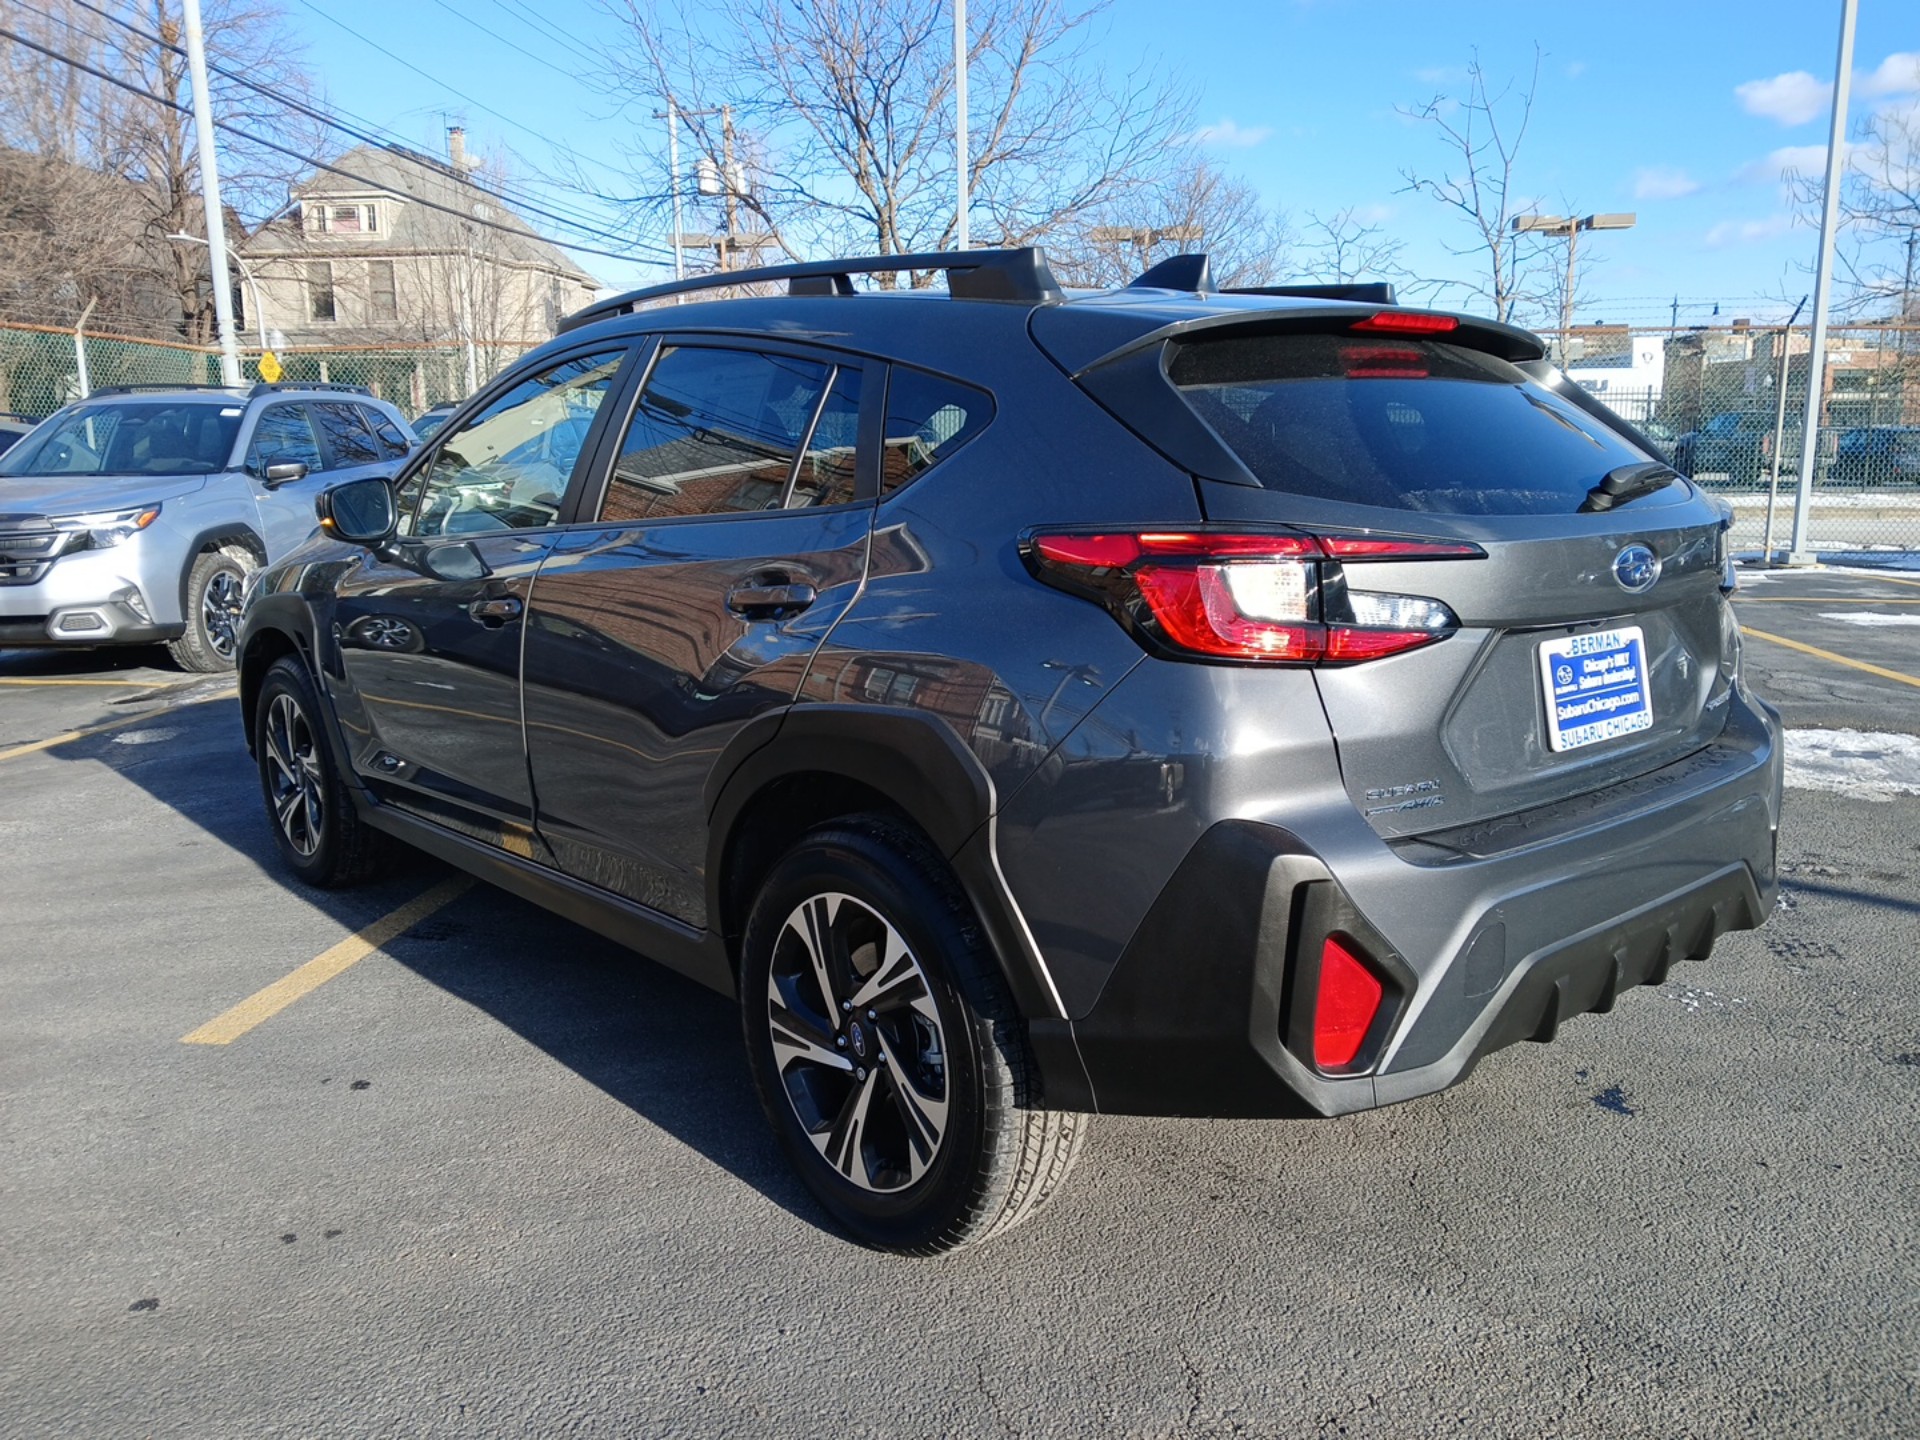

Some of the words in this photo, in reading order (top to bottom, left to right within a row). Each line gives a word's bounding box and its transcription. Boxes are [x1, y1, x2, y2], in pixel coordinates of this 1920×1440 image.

[1571, 632, 1620, 655] BERMAN
[1558, 692, 1640, 720] SubaruChicago.com
[1561, 723, 1604, 748] SUBARU
[1607, 712, 1650, 737] CHICAGO
